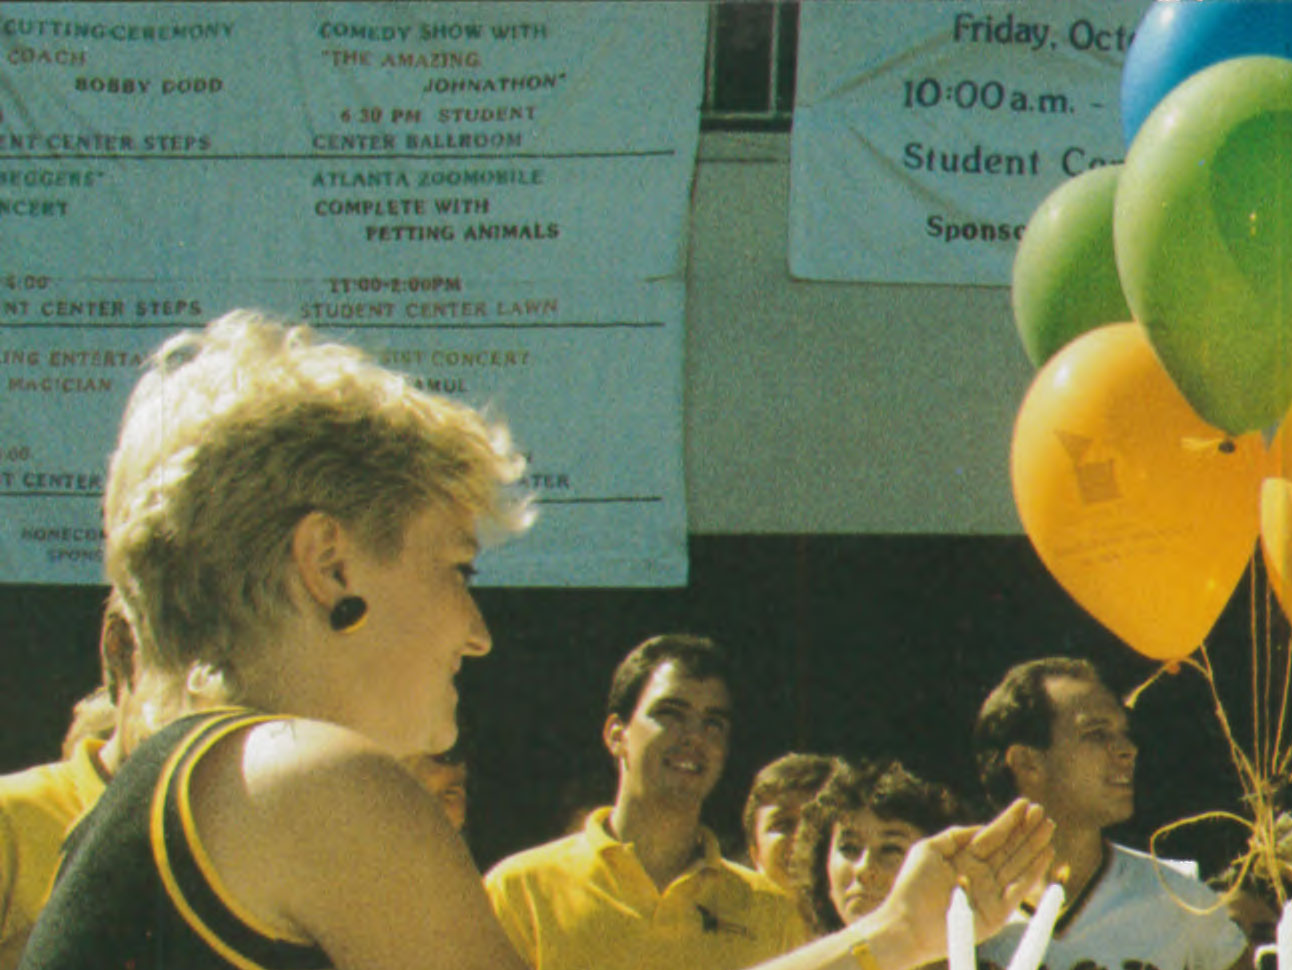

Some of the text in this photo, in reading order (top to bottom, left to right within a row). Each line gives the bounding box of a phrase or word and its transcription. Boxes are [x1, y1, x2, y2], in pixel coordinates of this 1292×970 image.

[318, 21, 548, 42] COMEDY SHOW WITH
[953, 12, 1059, 51] Friday,
[7, 47, 87, 67] COACH
[380, 52, 483, 69] AMAZING
[74, 77, 224, 95] BOBBY DODD
[437, 106, 537, 124] STUDENT
[46, 134, 133, 151] CENTER
[143, 134, 212, 151] STEPS
[311, 132, 523, 151] CENTER BALLROOM
[904, 142, 1039, 176] Student
[311, 168, 544, 188] ATLANTA ZOOMOBILE
[314, 198, 491, 217] COMPLETE WITH
[365, 221, 561, 242] PETTING ANIMALS
[41, 301, 125, 317] CENTER
[134, 300, 203, 317] STEPS
[300, 298, 559, 319] STUDENT CENTER LAWN
[432, 350, 530, 368] CONCERT
[22, 471, 103, 490] CENTER
